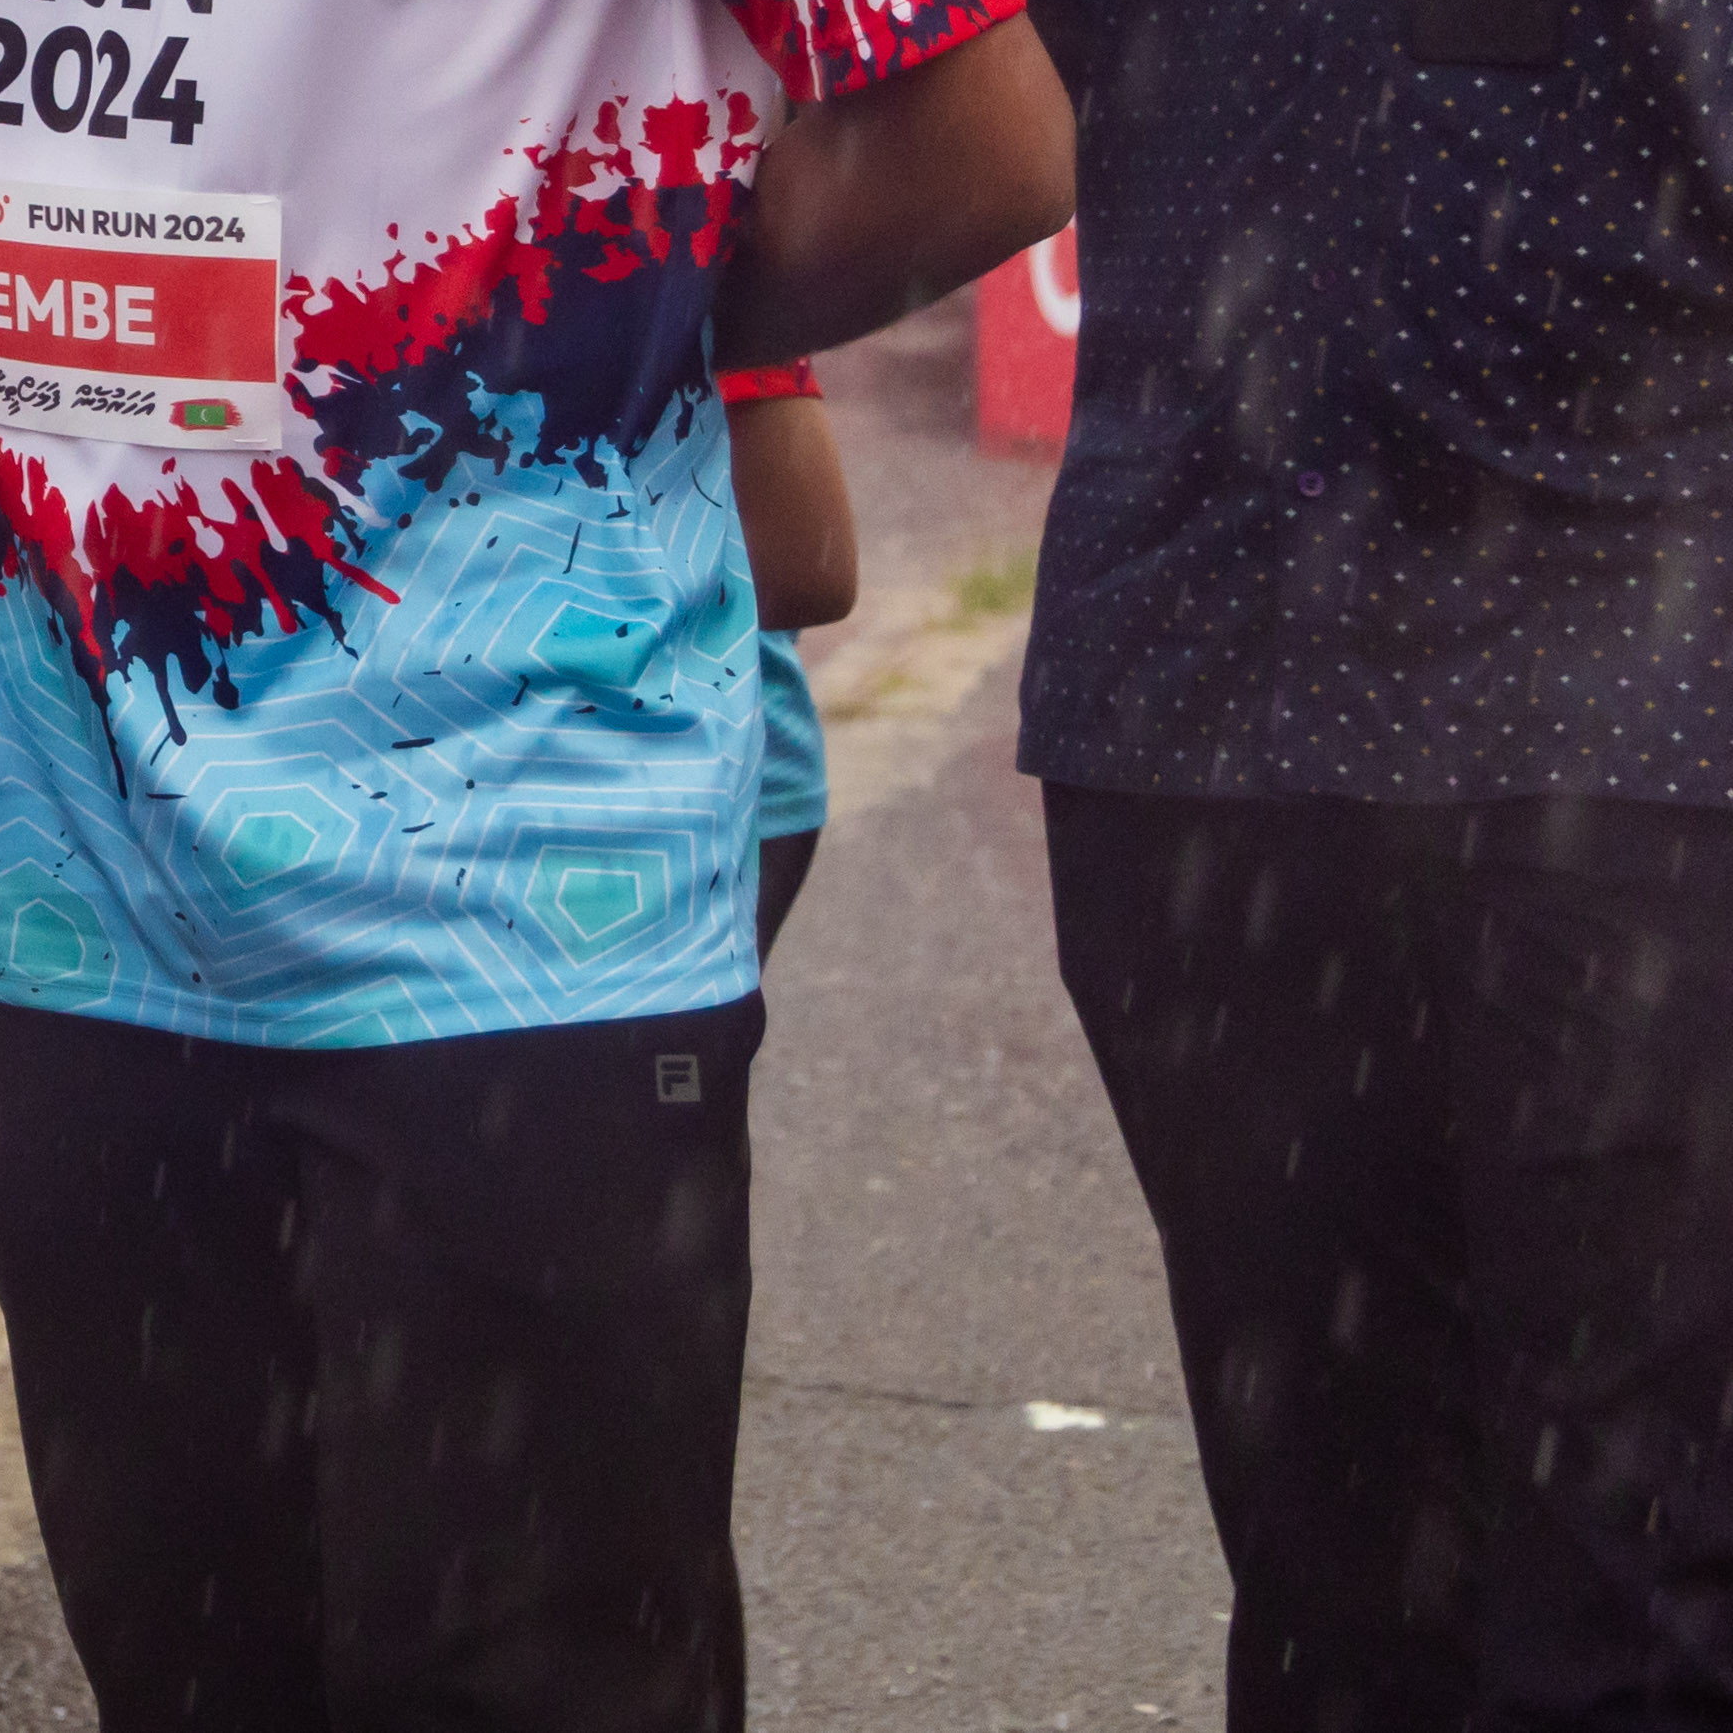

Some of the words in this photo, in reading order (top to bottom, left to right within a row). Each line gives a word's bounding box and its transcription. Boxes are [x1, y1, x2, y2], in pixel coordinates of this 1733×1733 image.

[28, 204, 85, 234] FUN
[92, 211, 156, 239] RUN
[163, 215, 245, 243] 2024
